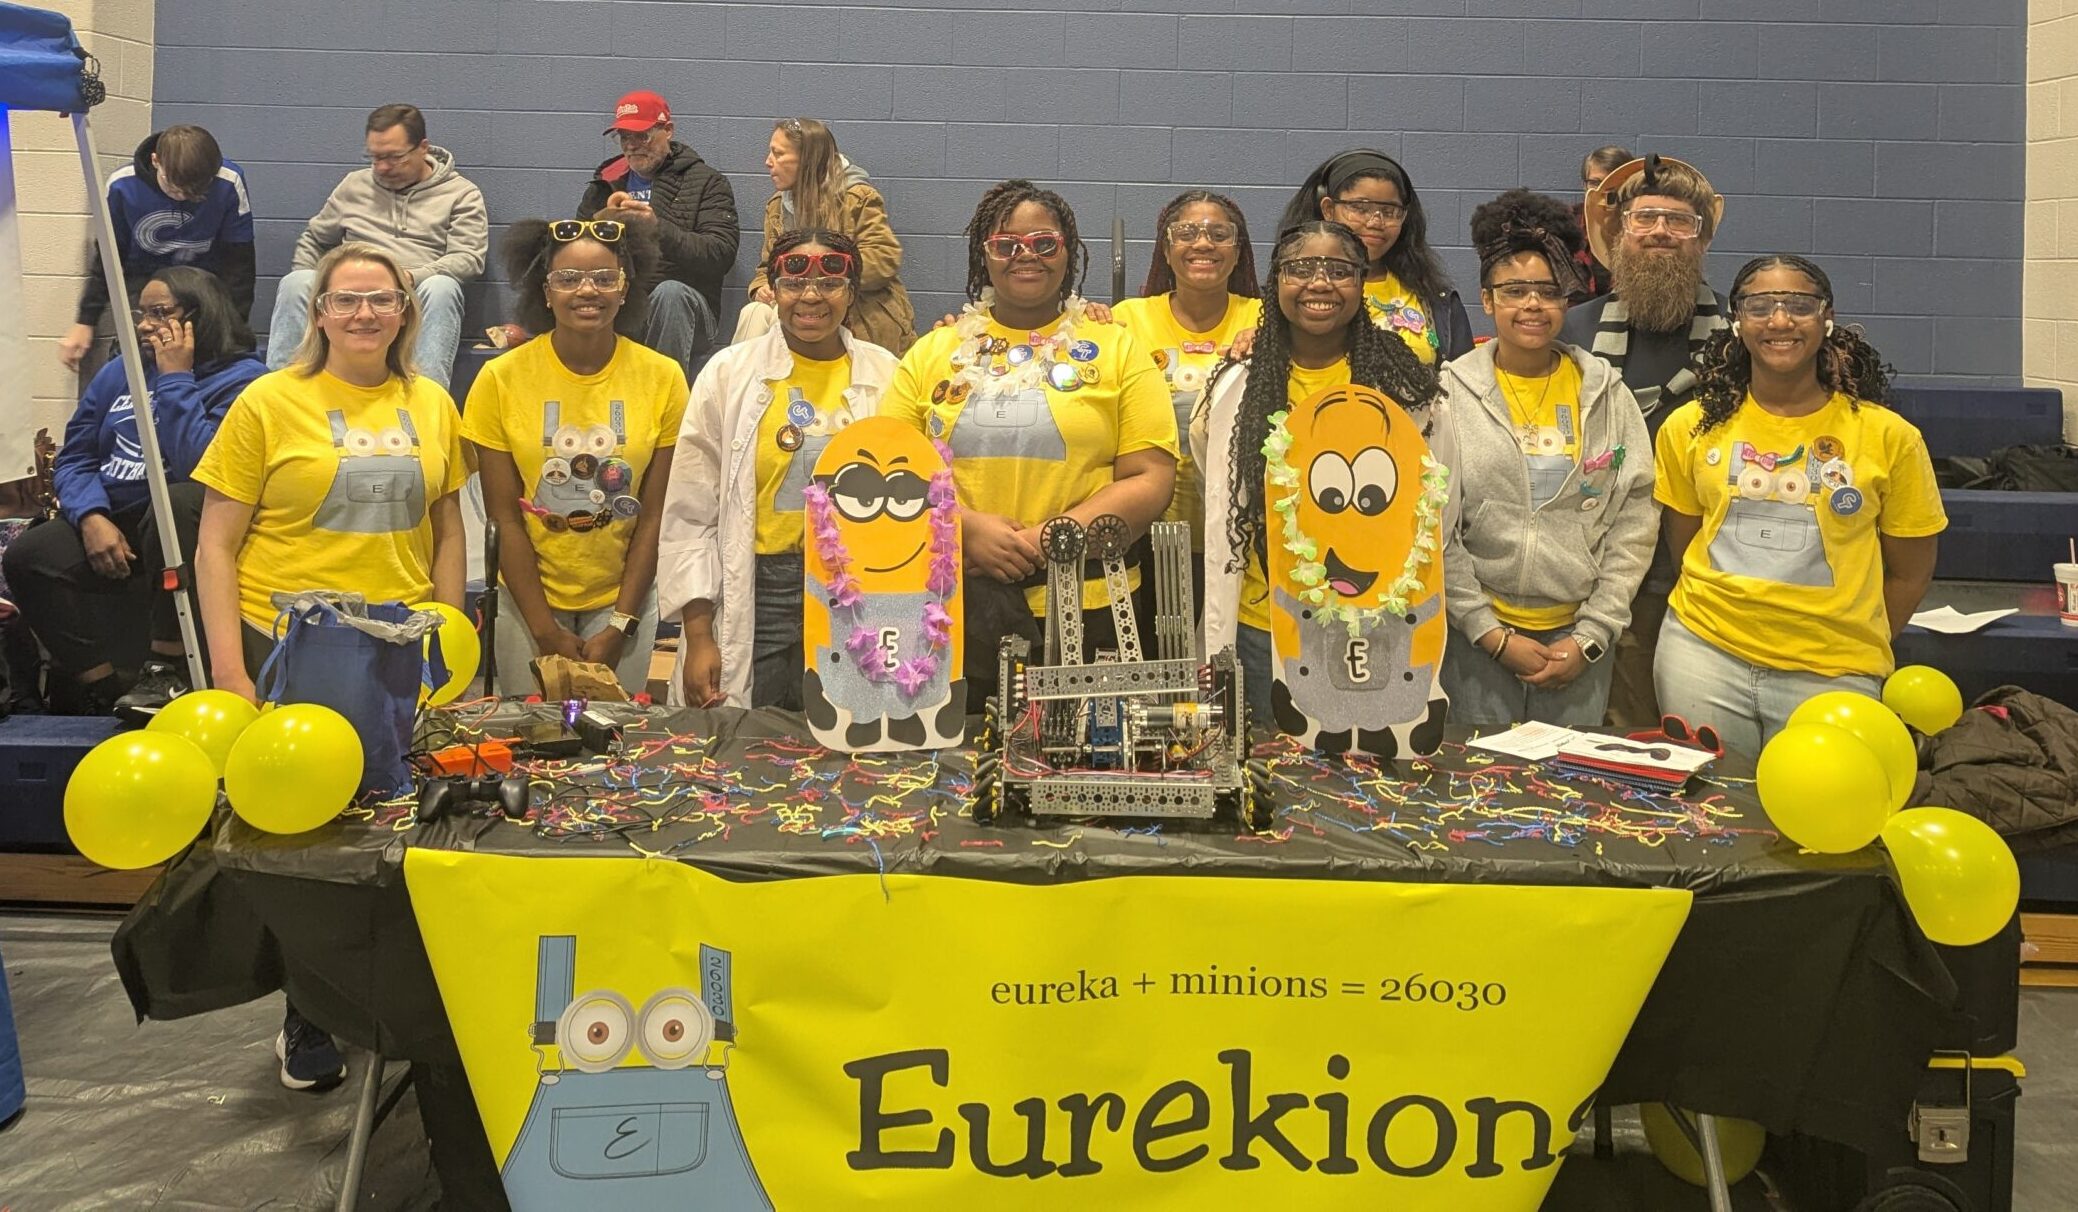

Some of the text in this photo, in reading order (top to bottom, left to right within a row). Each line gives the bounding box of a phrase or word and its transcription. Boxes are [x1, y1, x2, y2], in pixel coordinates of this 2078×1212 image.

[995, 410, 1007, 419] E
[372, 484, 384, 494] E
[574, 483, 586, 492] E
[1760, 528, 1772, 539] E
[709, 956, 725, 1016] 26030
[991, 970, 1120, 1005] eureka
[1133, 972, 1157, 995] +
[1170, 964, 1329, 999] minions
[1380, 973, 1508, 1011] 26030
